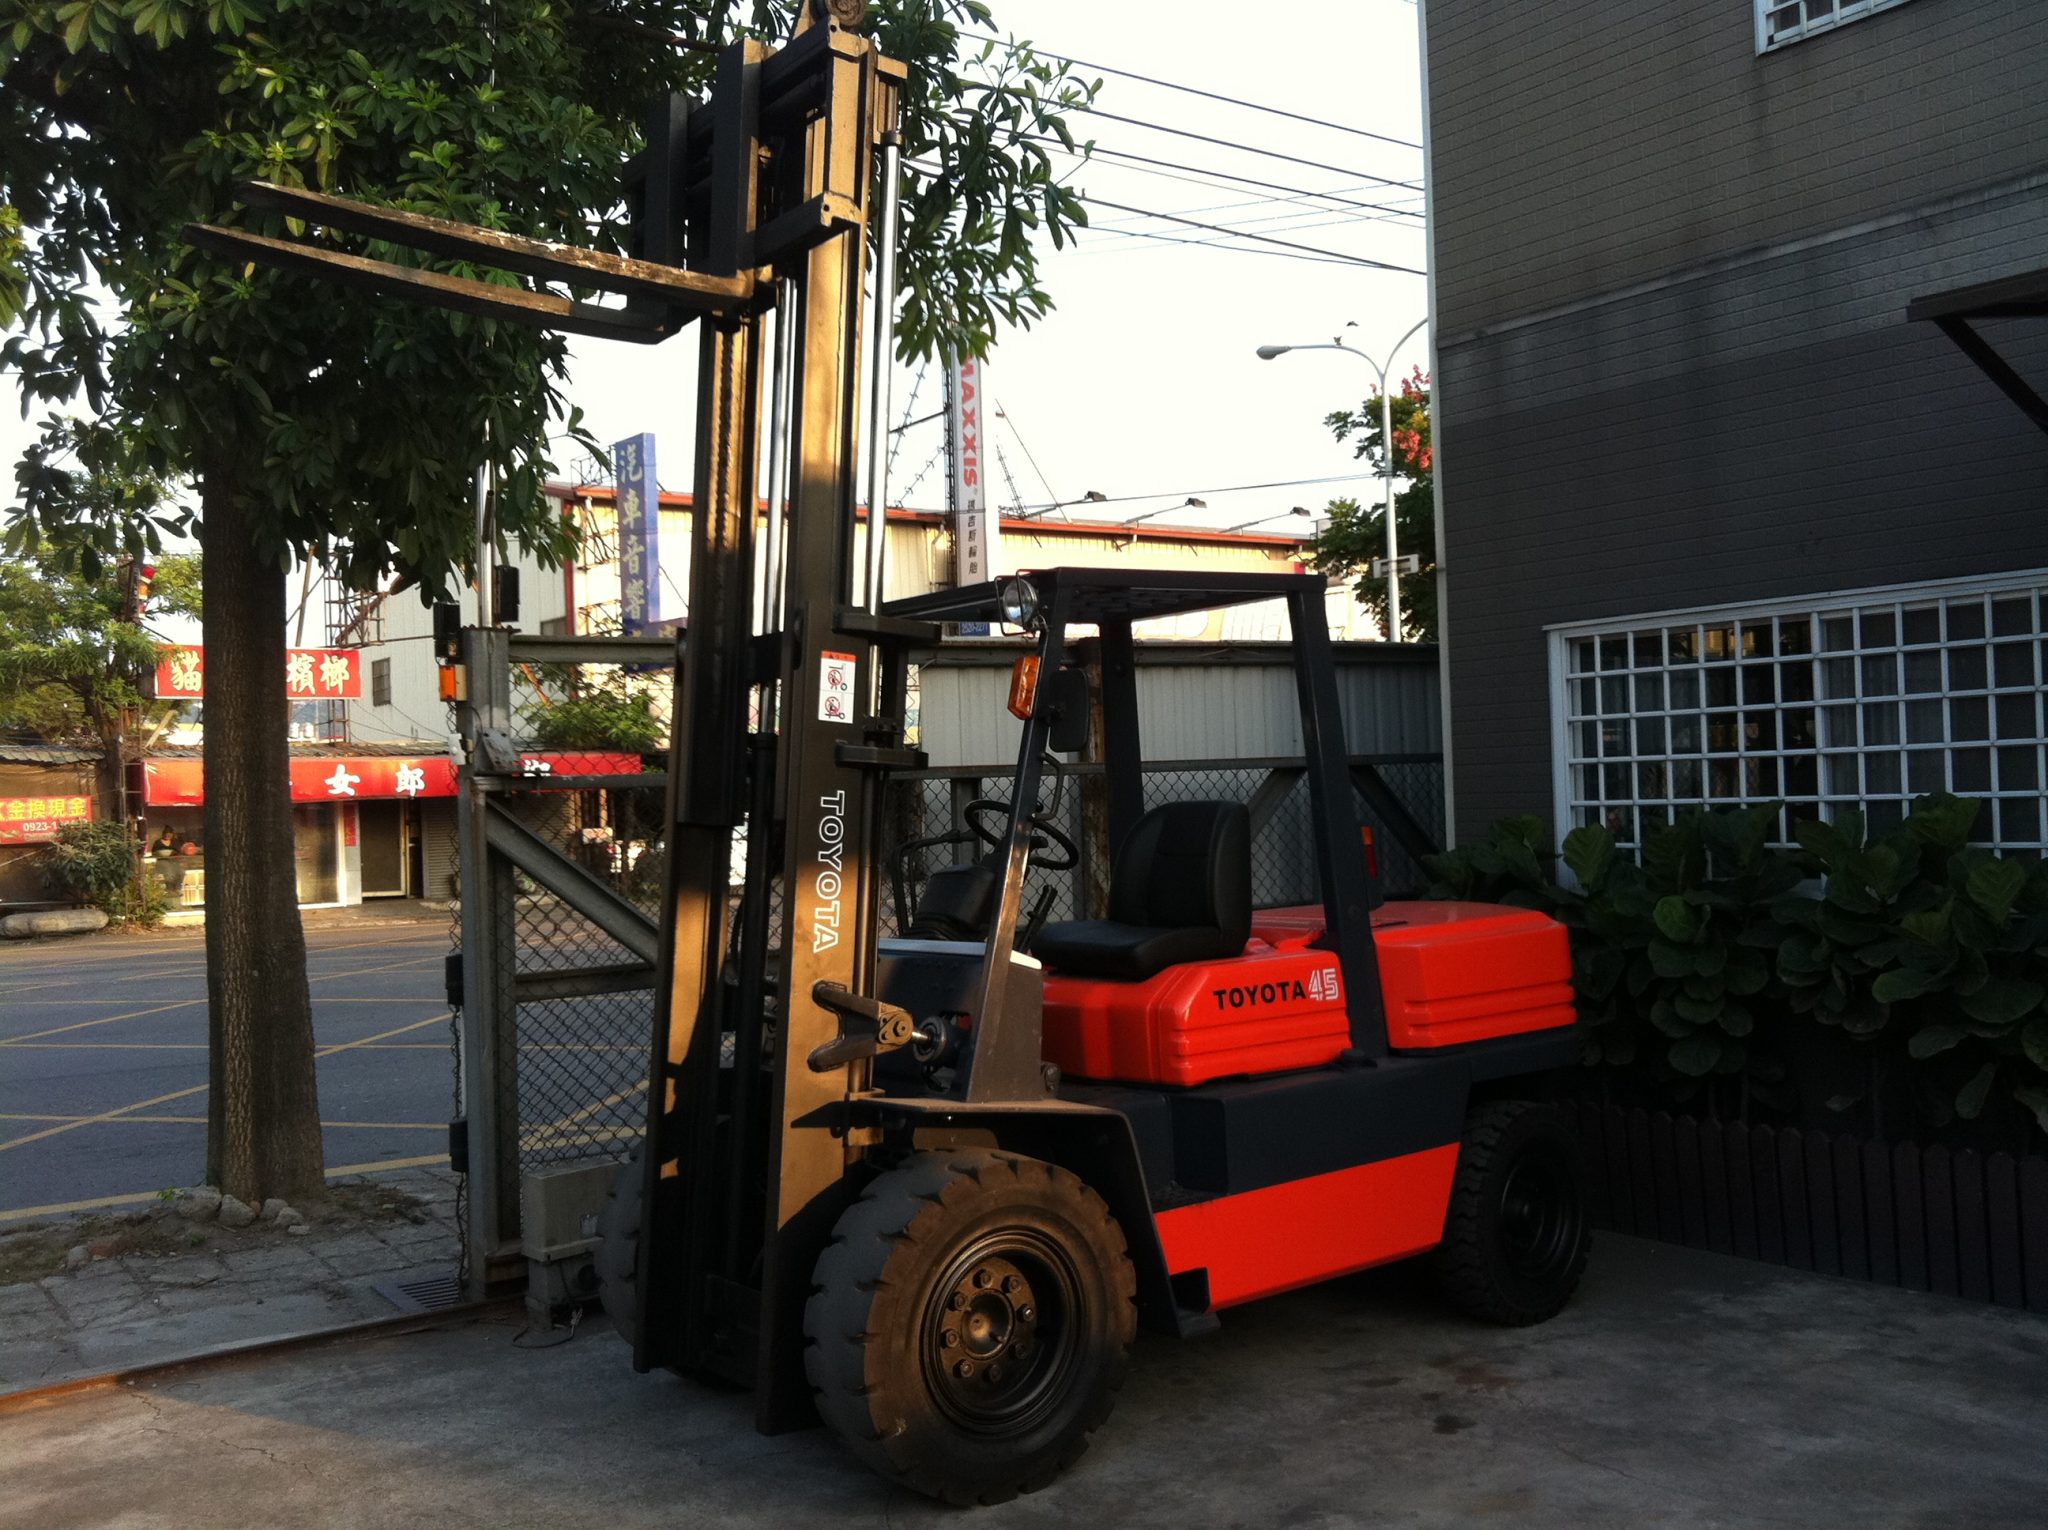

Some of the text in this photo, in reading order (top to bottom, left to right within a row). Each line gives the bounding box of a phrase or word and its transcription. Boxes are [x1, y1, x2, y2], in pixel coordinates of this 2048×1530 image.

[960, 351, 978, 487] MAXXIS
[620, 443, 645, 620] 汽車音響
[813, 789, 845, 953] TOYOTA
[1213, 968, 1339, 1010] TOYOTA 45
